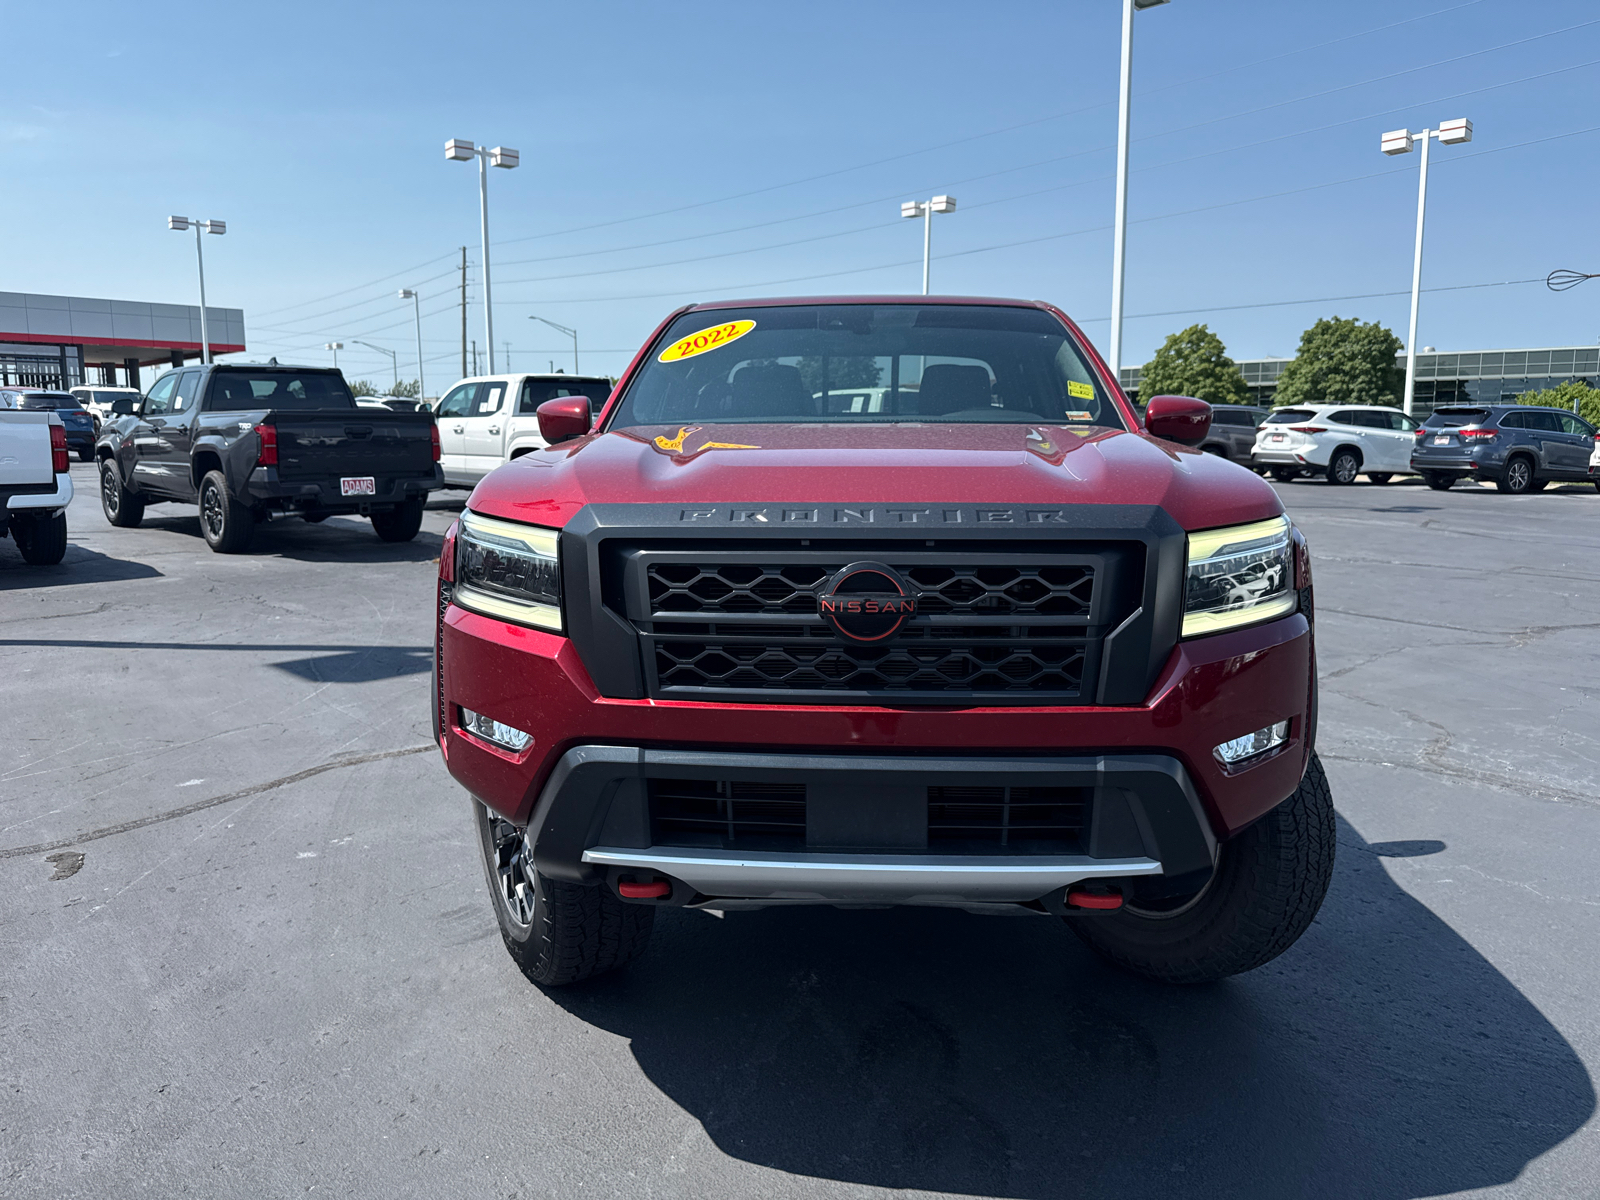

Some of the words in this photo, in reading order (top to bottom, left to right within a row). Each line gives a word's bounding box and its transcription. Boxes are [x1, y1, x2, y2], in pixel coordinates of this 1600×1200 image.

[678, 324, 739, 357] 2022
[344, 480, 373, 492] ADAMS
[679, 508, 1069, 523] FRONTIER
[821, 600, 914, 613] NISSAN
